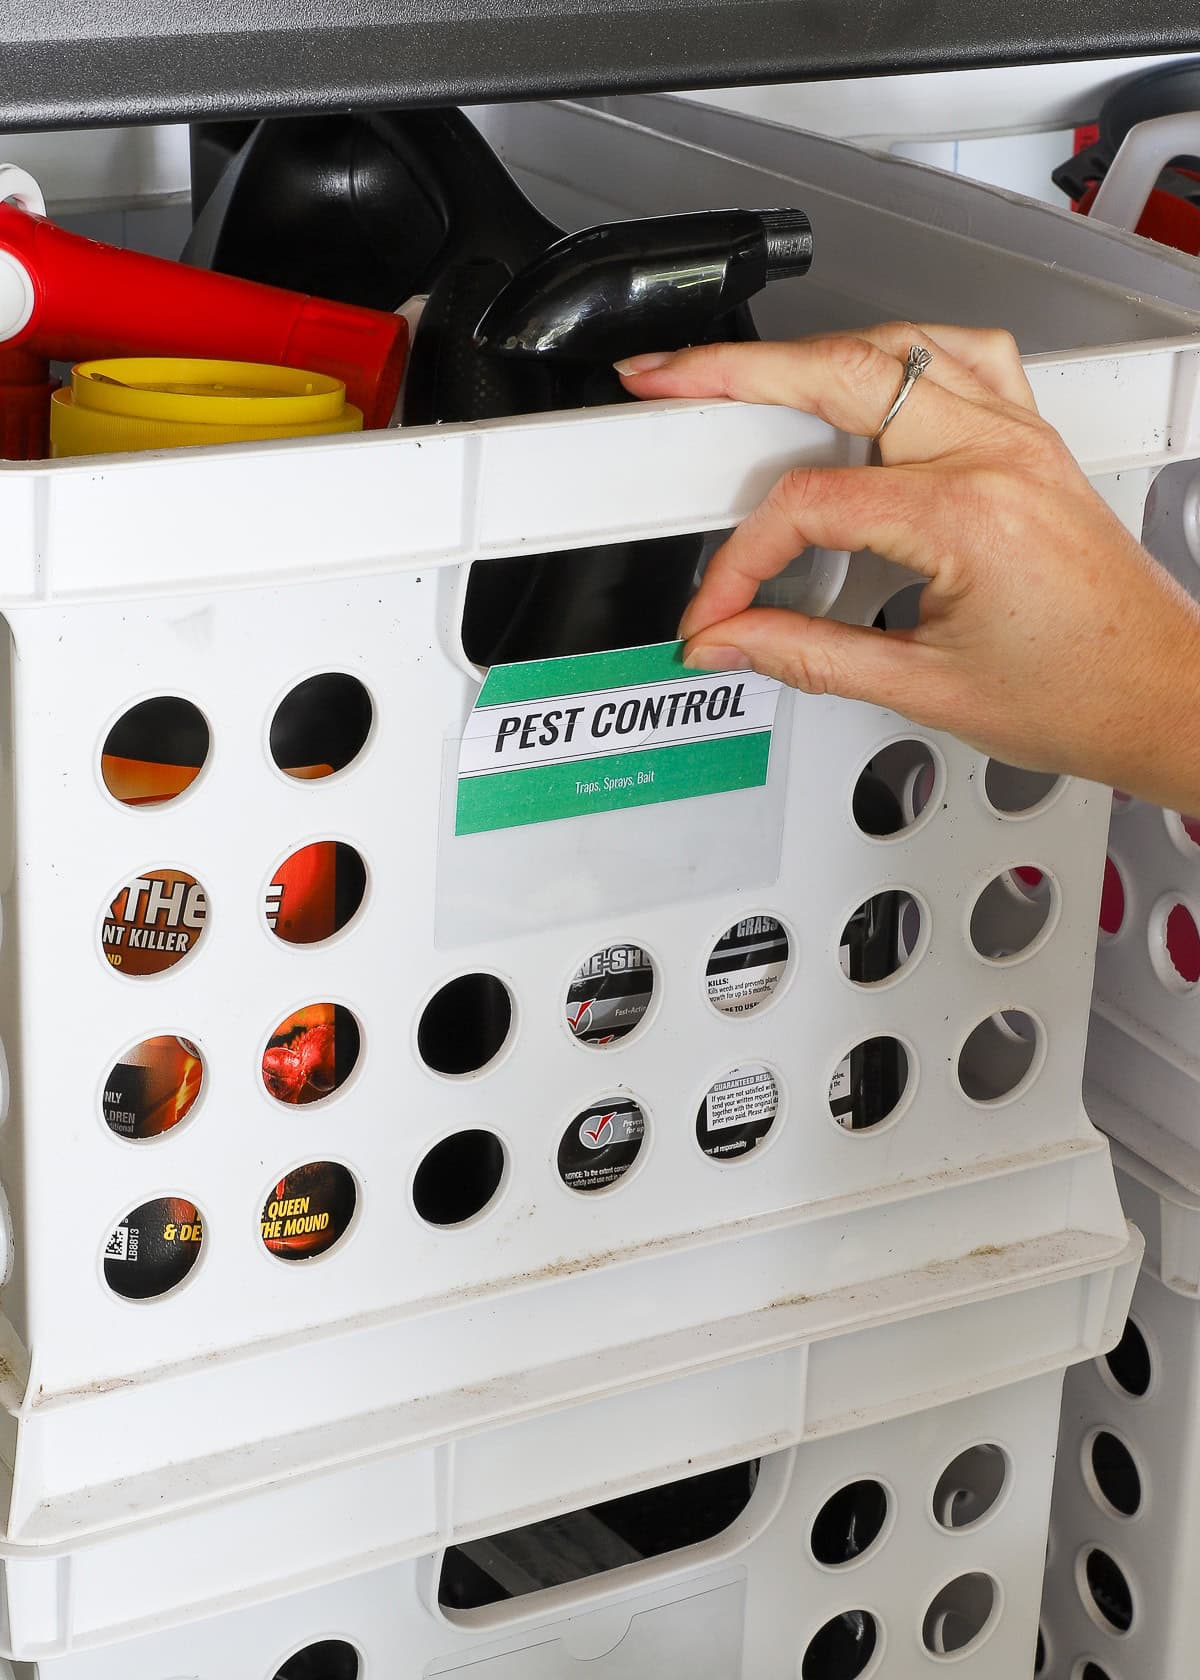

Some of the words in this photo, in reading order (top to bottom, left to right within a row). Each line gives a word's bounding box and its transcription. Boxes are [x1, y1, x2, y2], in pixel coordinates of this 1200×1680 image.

[494, 706, 586, 753] PEST
[590, 683, 746, 739] CONTROL
[575, 781, 601, 796] Traps,
[603, 776, 635, 792] Sprays,
[637, 770, 655, 785] Bait
[736, 916, 779, 938] GRASS
[129, 928, 189, 952] KILLER
[707, 978, 729, 988] KILLS:
[707, 987, 718, 995] Kills
[744, 979, 765, 989] prevents
[735, 991, 742, 999] up
[735, 1005, 744, 1013] TO
[713, 1077, 755, 1092] GUARANTEED
[104, 1091, 122, 1104] NLY
[711, 1095, 716, 1103] If
[717, 1095, 726, 1103] you
[736, 1090, 744, 1098] not
[745, 1085, 765, 1096] satisfied
[711, 1102, 724, 1110] send
[724, 1099, 736, 1109] your
[737, 1095, 754, 1104] written
[755, 1091, 772, 1102] request
[711, 1108, 733, 1119] together
[734, 1105, 745, 1113] with
[754, 1098, 773, 1108] original
[712, 1117, 725, 1126] price
[725, 1115, 735, 1124] you
[747, 1108, 763, 1117] Please
[590, 1169, 599, 1177] the
[599, 1167, 614, 1175] extent
[573, 1178, 587, 1187] safety
[587, 1177, 597, 1185] and
[268, 1197, 310, 1221] QUEEN
[164, 1223, 178, 1241] &
[180, 1223, 203, 1242] DE
[261, 1220, 283, 1239] THE
[283, 1212, 329, 1237] MOUND
[127, 1228, 140, 1262] LB8813
